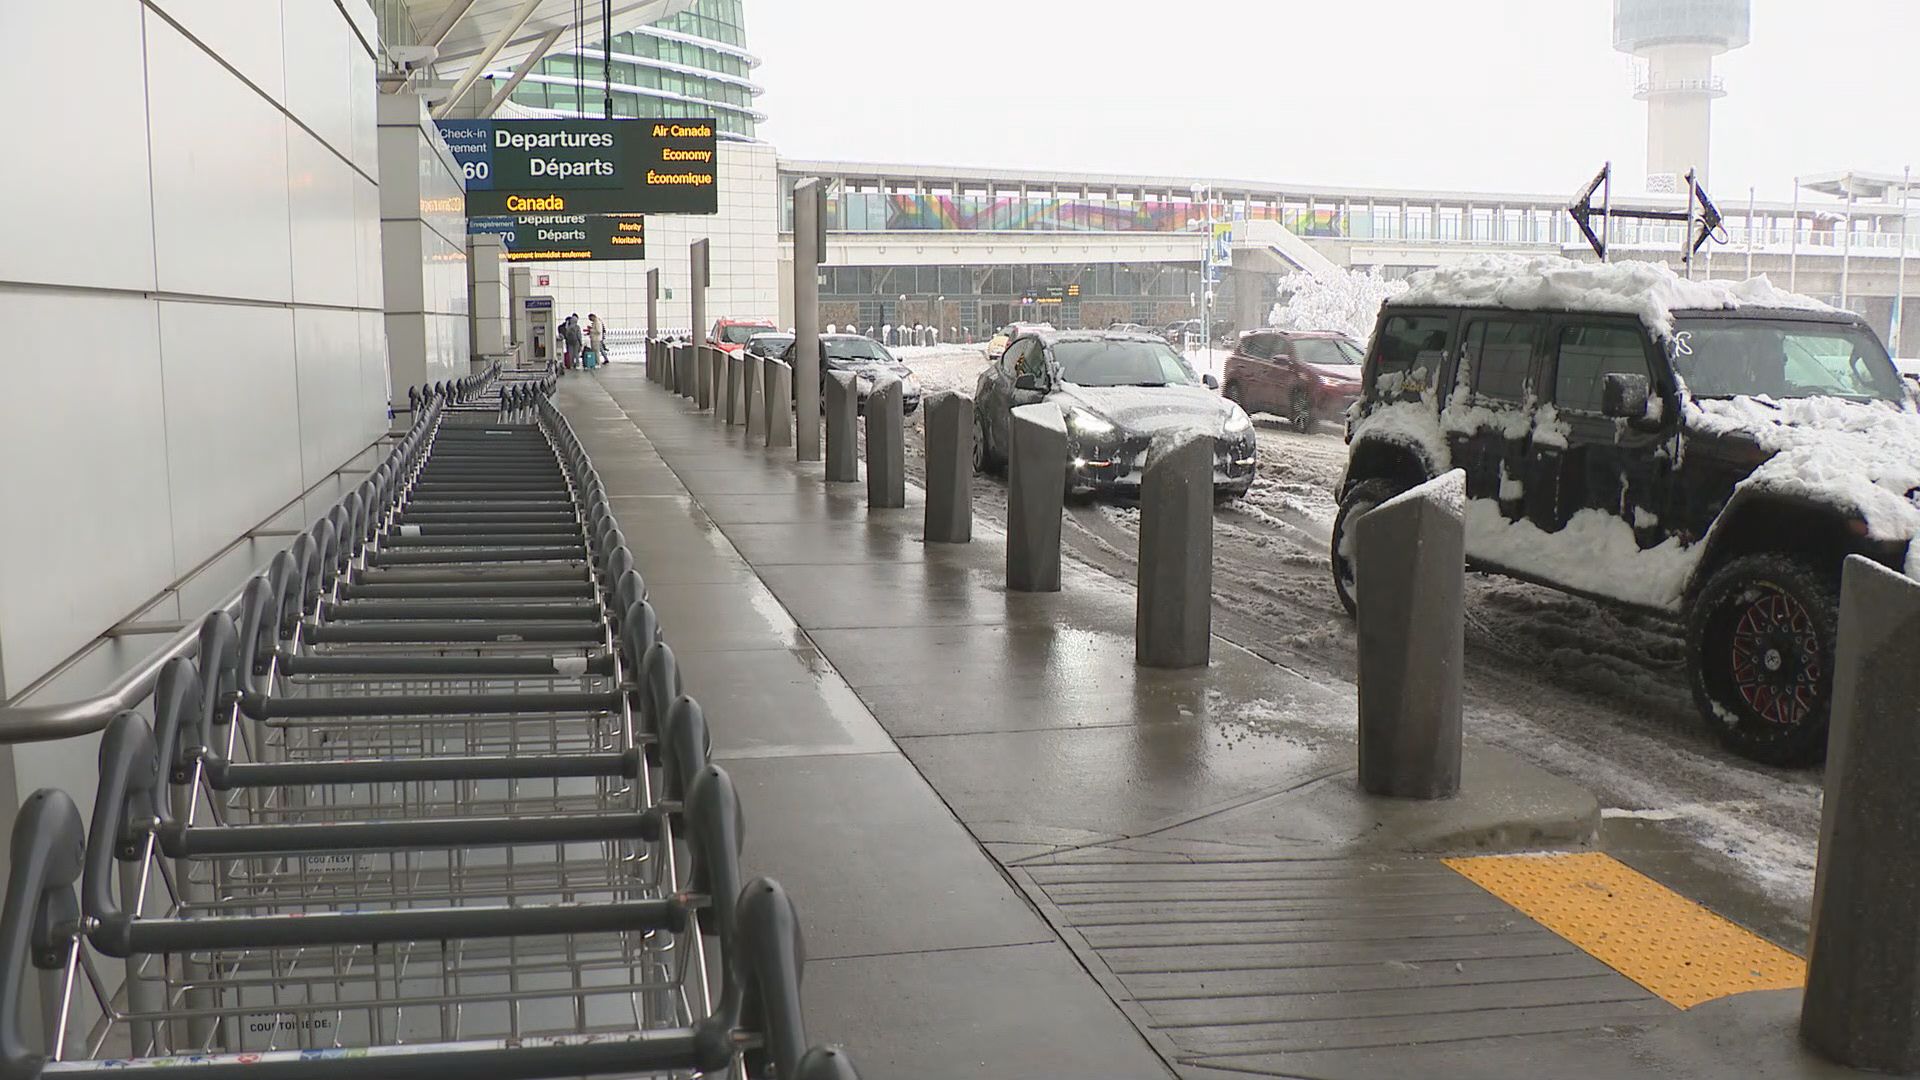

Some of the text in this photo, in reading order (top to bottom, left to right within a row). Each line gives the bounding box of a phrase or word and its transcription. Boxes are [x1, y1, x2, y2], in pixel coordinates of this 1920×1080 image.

[440, 128, 487, 139] Check-in
[653, 124, 711, 137] Air Canada
[495, 129, 614, 151] Departures
[447, 143, 487, 153] trement
[663, 148, 711, 163] Economy
[462, 161, 489, 179] 60
[530, 158, 615, 179] Départs
[647, 170, 712, 186] Économique
[507, 194, 564, 211] Canada
[518, 215, 586, 227] Departures
[619, 222, 642, 232] Priority
[537, 229, 586, 241] Départs
[612, 236, 642, 245] Prioritaire
[561, 250, 592, 259] seulement
[250, 1021, 310, 1032] COUTOIIE
